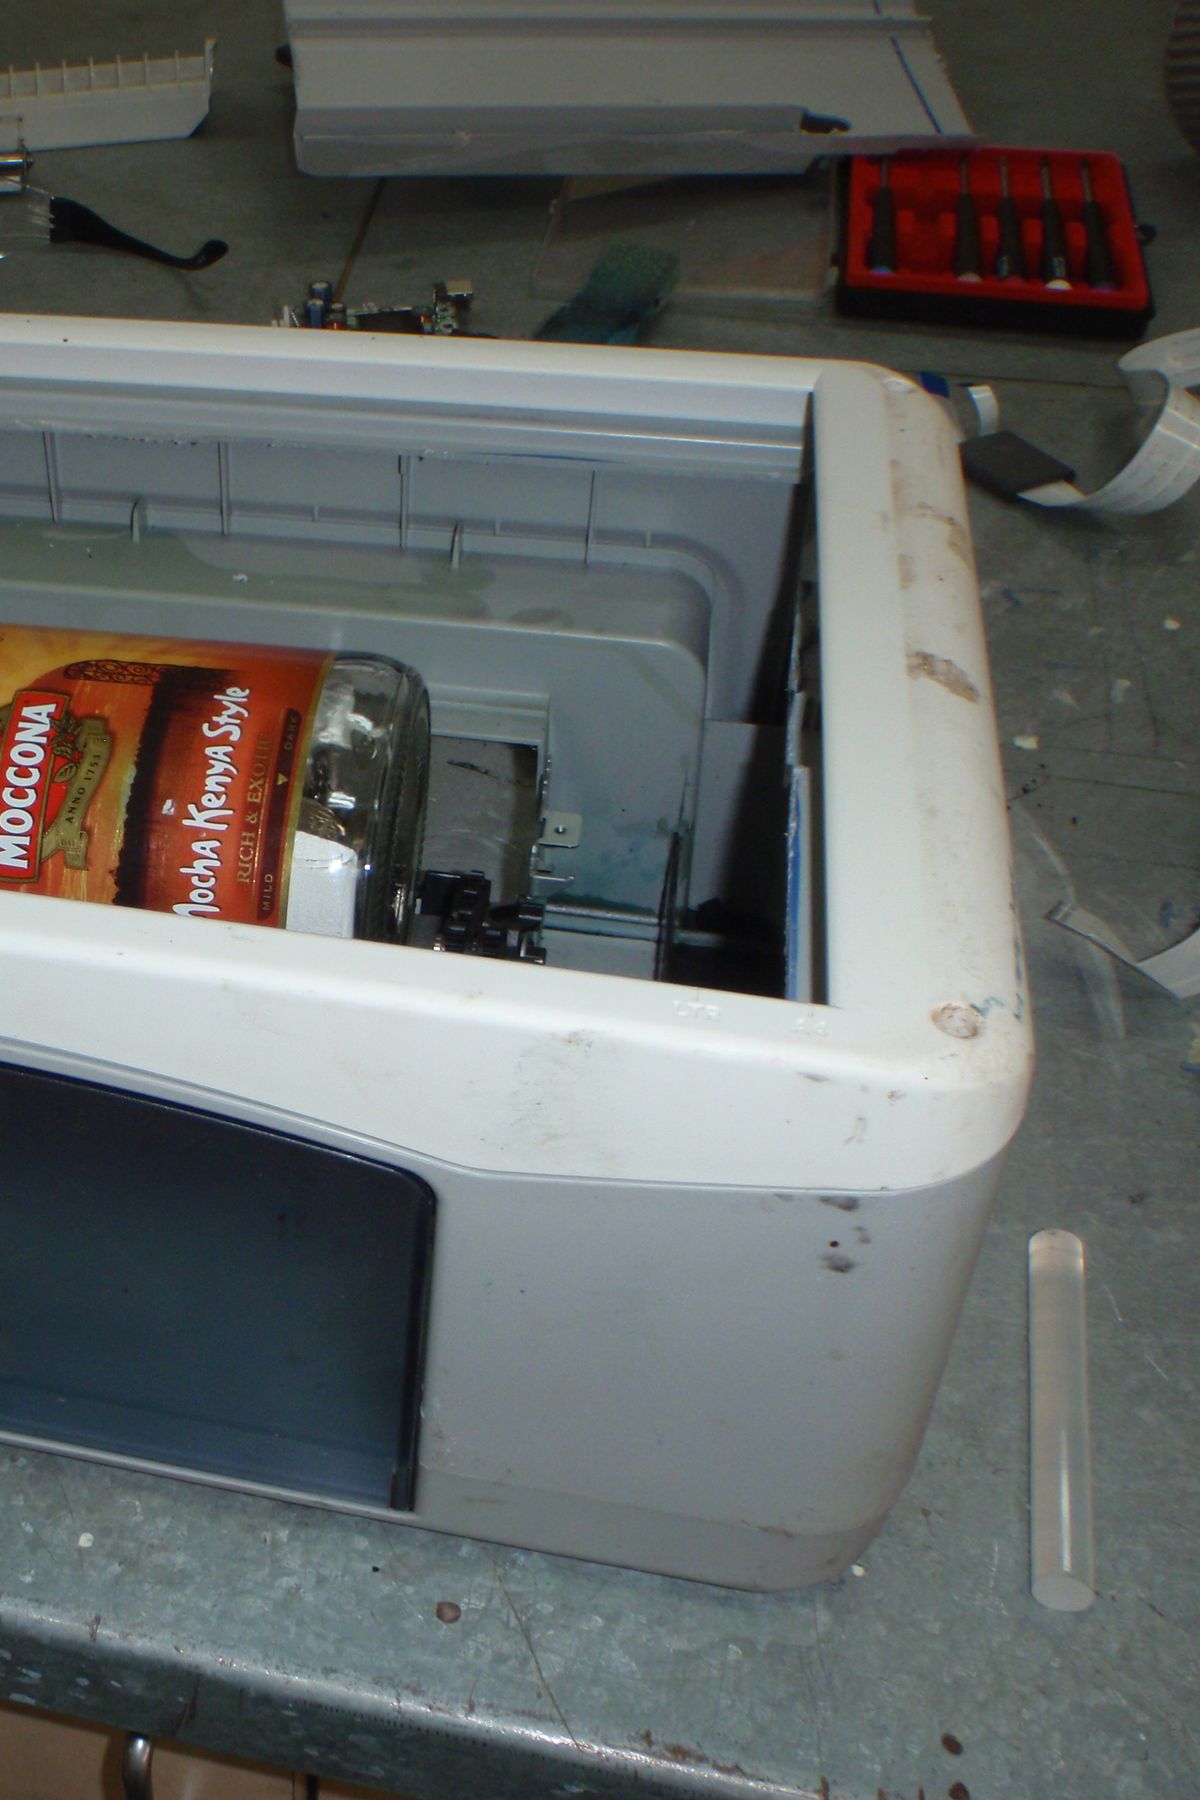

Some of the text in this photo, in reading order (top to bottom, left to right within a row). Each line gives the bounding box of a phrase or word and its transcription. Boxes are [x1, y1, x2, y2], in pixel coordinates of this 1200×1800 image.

[202, 686, 251, 742] Style
[64, 787, 87, 824] ANNO
[84, 753, 103, 782] 1753
[245, 811, 259, 824] &
[237, 831, 256, 885] RICH
[262, 872, 274, 911] MILD
